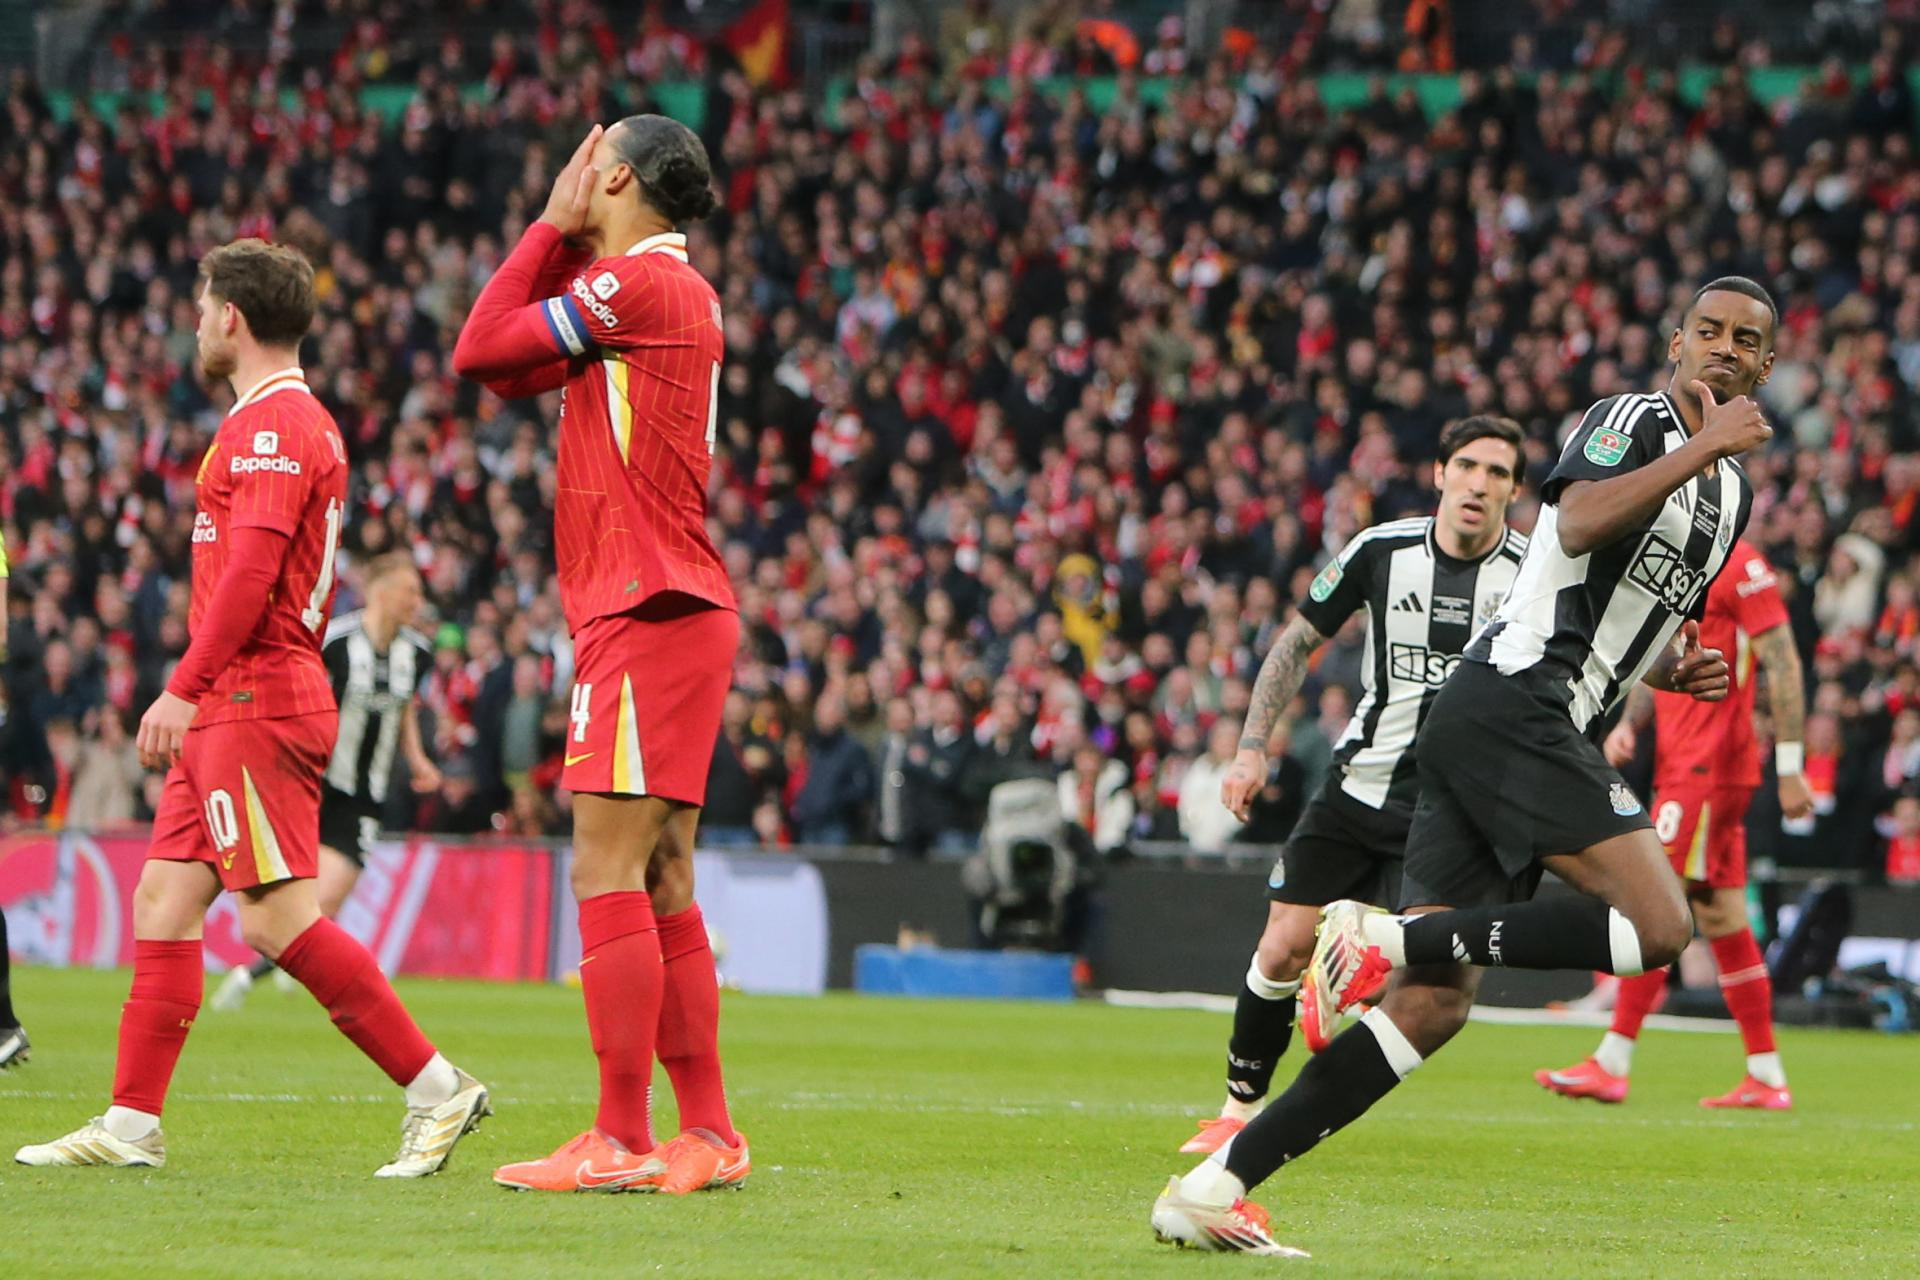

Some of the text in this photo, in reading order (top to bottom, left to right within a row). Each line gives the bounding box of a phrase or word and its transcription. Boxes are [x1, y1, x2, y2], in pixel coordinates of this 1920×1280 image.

[230, 456, 301, 475] Expedia
[302, 496, 344, 633] 1
[1663, 568, 1704, 613] sel
[570, 683, 592, 742] 4
[1656, 800, 1683, 844] 8
[1488, 921, 1504, 966] NUF
[1228, 1053, 1262, 1070] UFC
